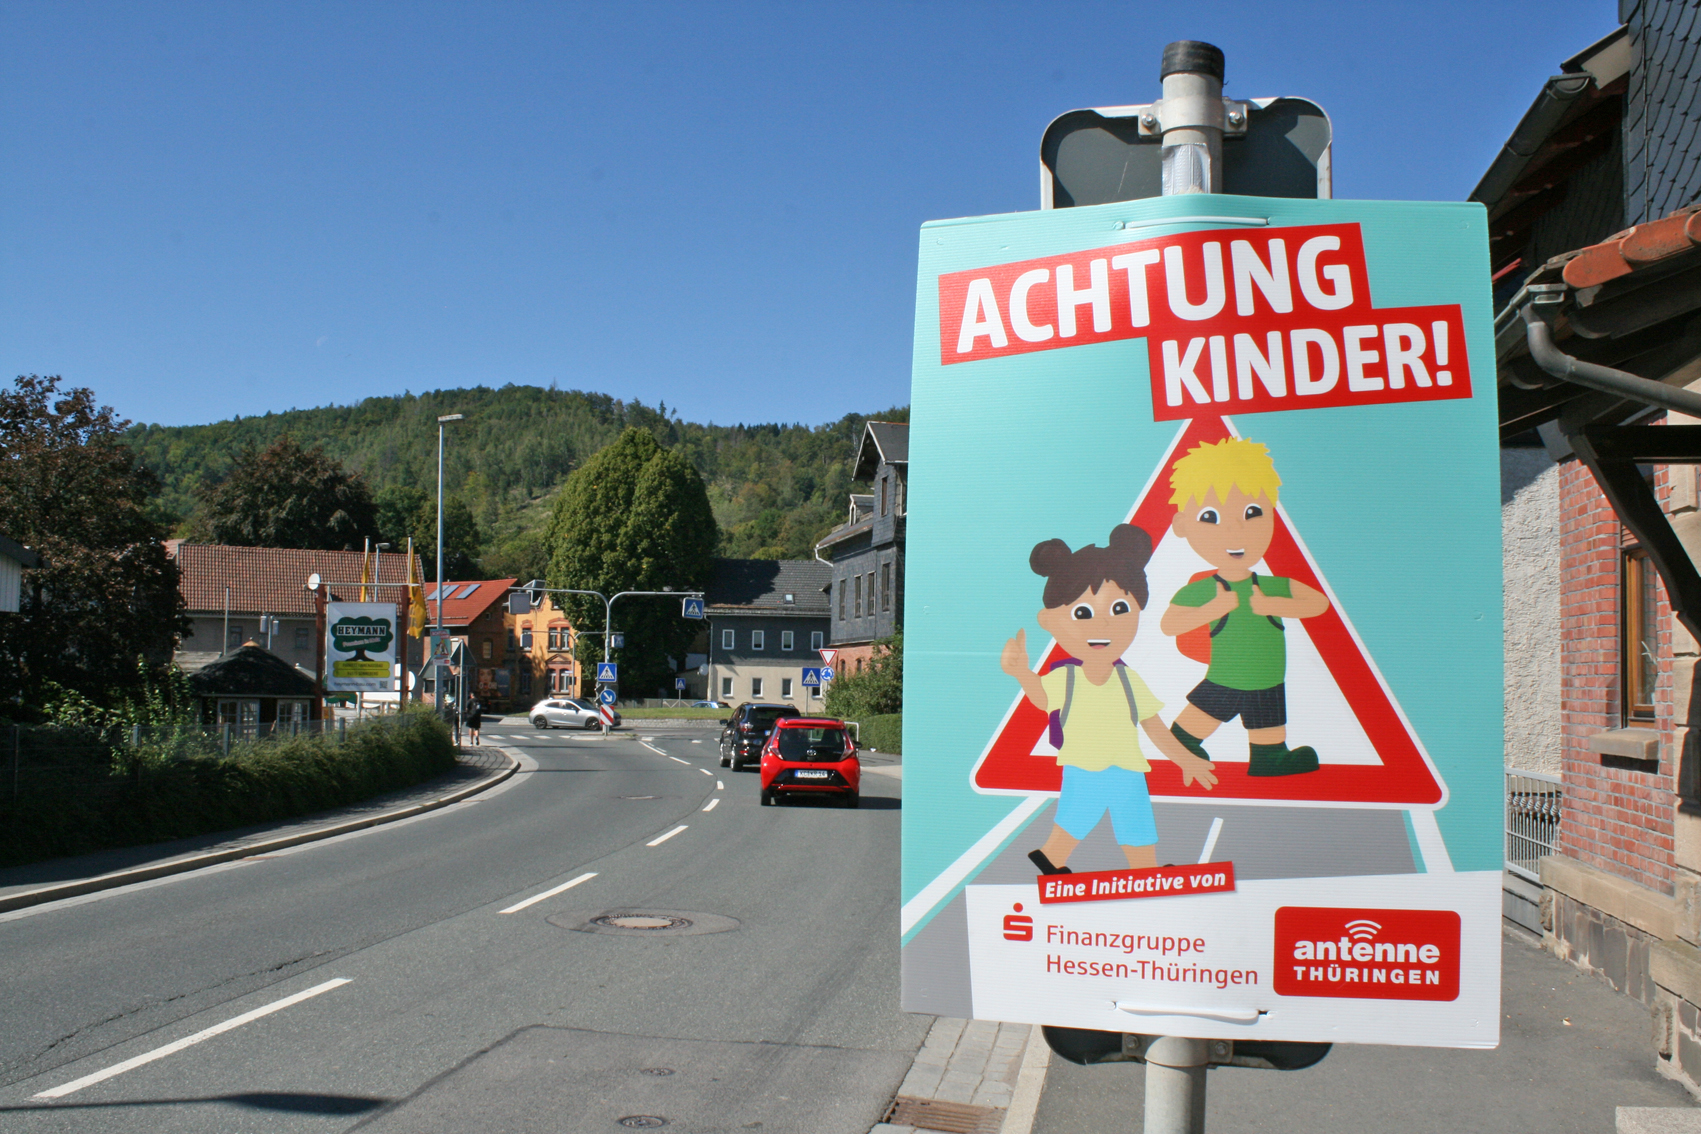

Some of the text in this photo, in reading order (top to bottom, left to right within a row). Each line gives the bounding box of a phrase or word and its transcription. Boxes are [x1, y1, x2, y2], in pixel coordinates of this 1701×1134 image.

[956, 235, 1354, 353] ACHTUNG
[1161, 320, 1453, 407] KINDER!
[337, 626, 386, 635] HEYMANN
[1045, 872, 1226, 898] Eine Initiative von
[1046, 924, 1206, 957] Finanzgruppe
[1293, 936, 1441, 964] antenne
[1046, 954, 1259, 989] Hessen-Thüringen
[1293, 964, 1440, 985] THÜRINGEN
